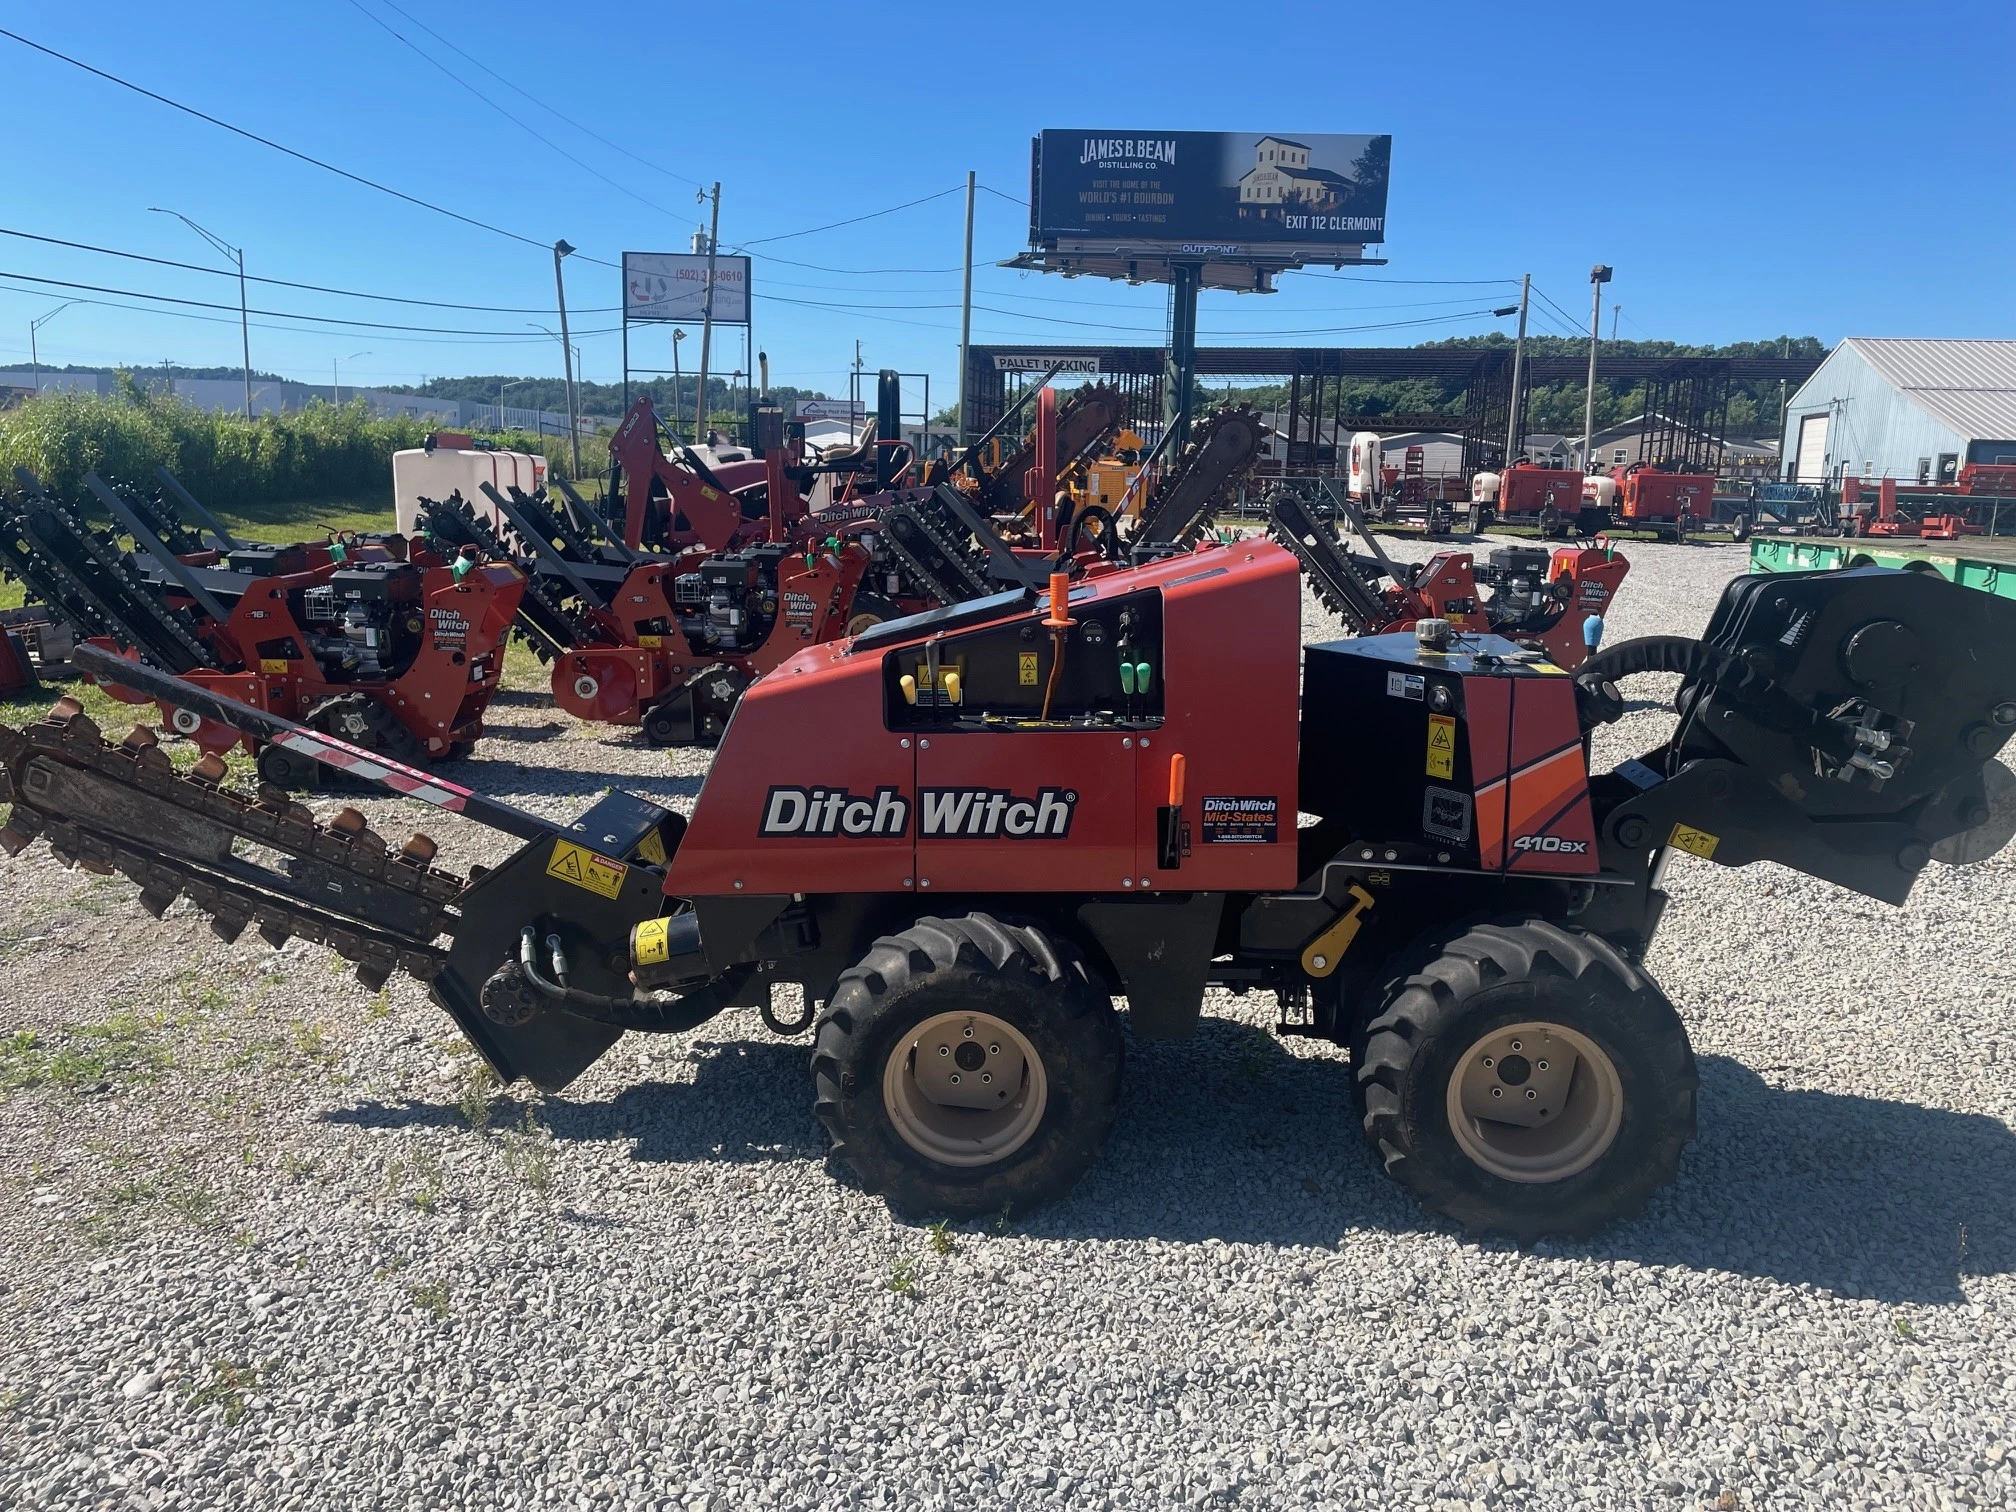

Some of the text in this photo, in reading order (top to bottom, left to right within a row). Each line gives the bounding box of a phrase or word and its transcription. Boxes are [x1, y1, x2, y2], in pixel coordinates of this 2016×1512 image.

[1080, 139, 1176, 165] JAMES B. BEAM
[1099, 161, 1158, 170] DISTILLING CO.
[1093, 180, 1161, 190] VISIT THE HOME OF THE
[1079, 191, 1175, 205] WORLD'S #1 BOURBON
[1085, 213, 1167, 223] DINING TOURS TASTINGS
[1286, 215, 1384, 232] EXIT 112 CLERMONT
[676, 269, 742, 282] (502) 35-0610
[999, 358, 1096, 373] PALLET RACKING
[623, 412, 640, 438] A323
[820, 509, 849, 523] Ditch
[1580, 581, 1604, 589] Ditch
[783, 592, 810, 601] Ditch
[1585, 589, 1610, 597] Witch
[790, 601, 817, 610] Witch
[430, 608, 460, 619] Ditch
[438, 620, 470, 630] Witch
[764, 790, 905, 833] Ditch
[1204, 812, 1274, 822] Mid-States
[600, 857, 624, 871] DANGER
